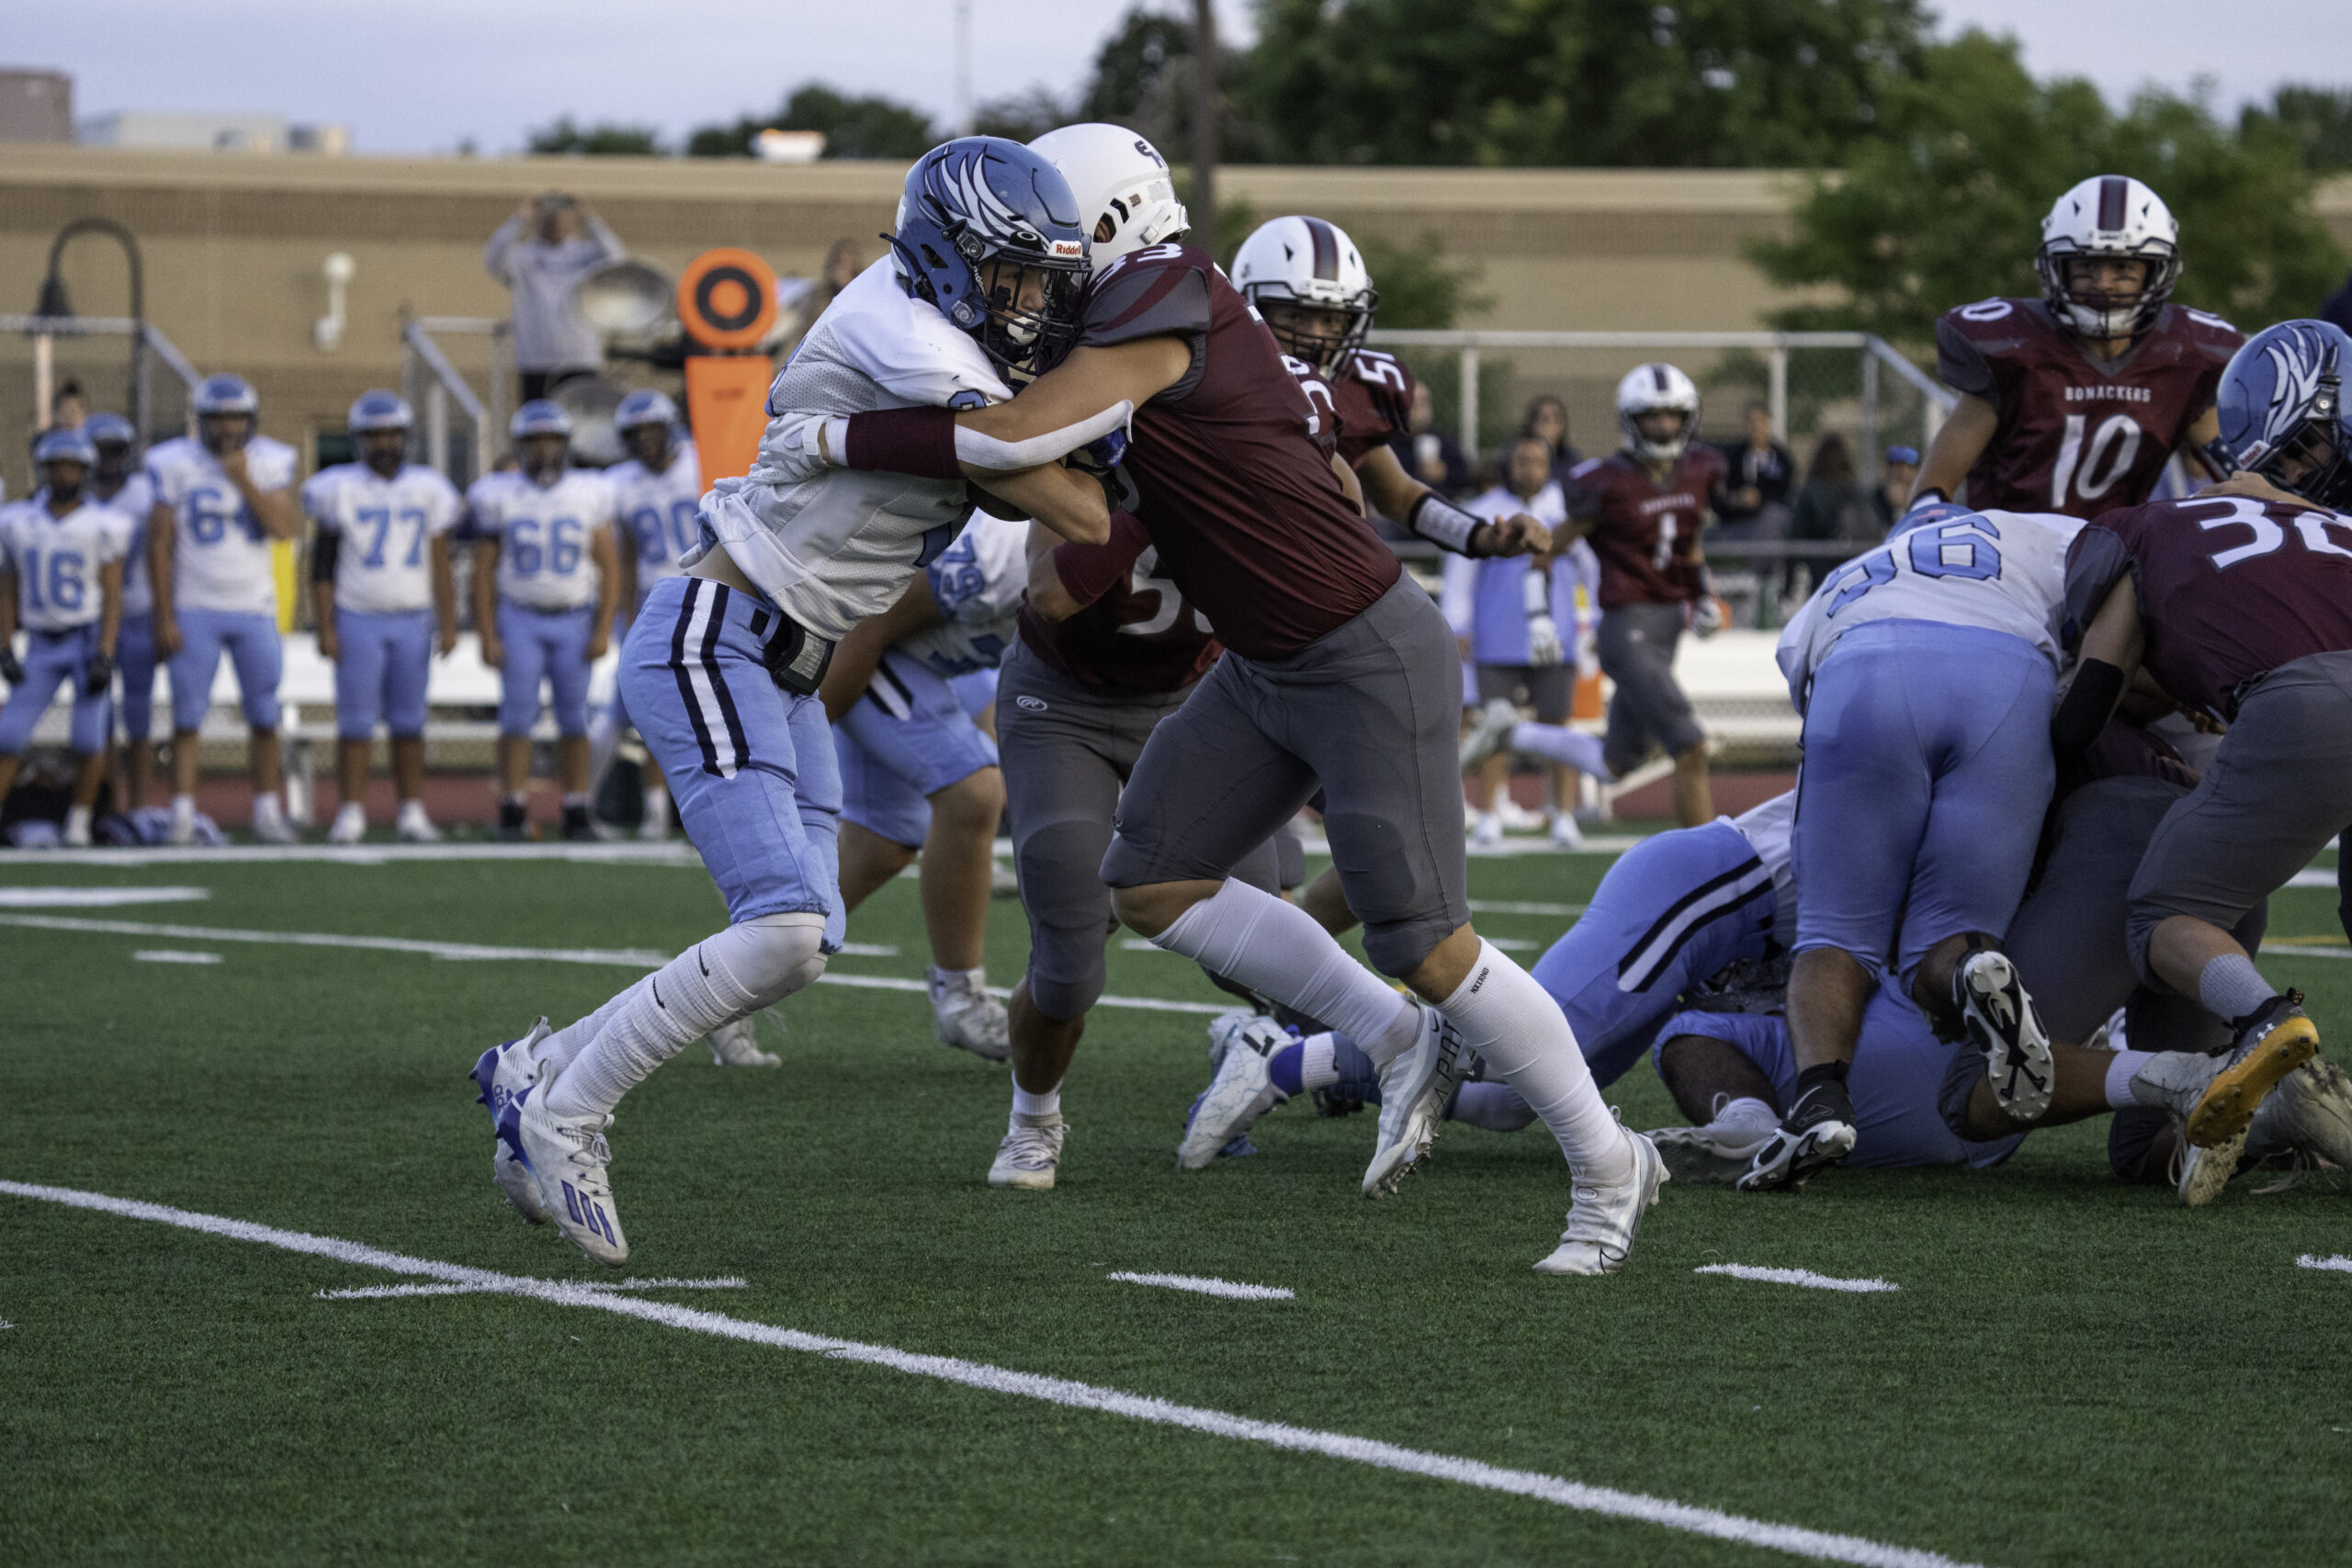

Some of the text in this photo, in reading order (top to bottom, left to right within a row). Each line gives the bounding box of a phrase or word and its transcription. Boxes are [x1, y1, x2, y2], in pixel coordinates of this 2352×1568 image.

[1056, 243, 1081, 255] Riddell
[2064, 386, 2151, 402] BONACKERS
[2051, 413, 2141, 508] 10
[356, 508, 425, 567] 77
[508, 517, 582, 576] 66
[24, 548, 85, 611] 16
